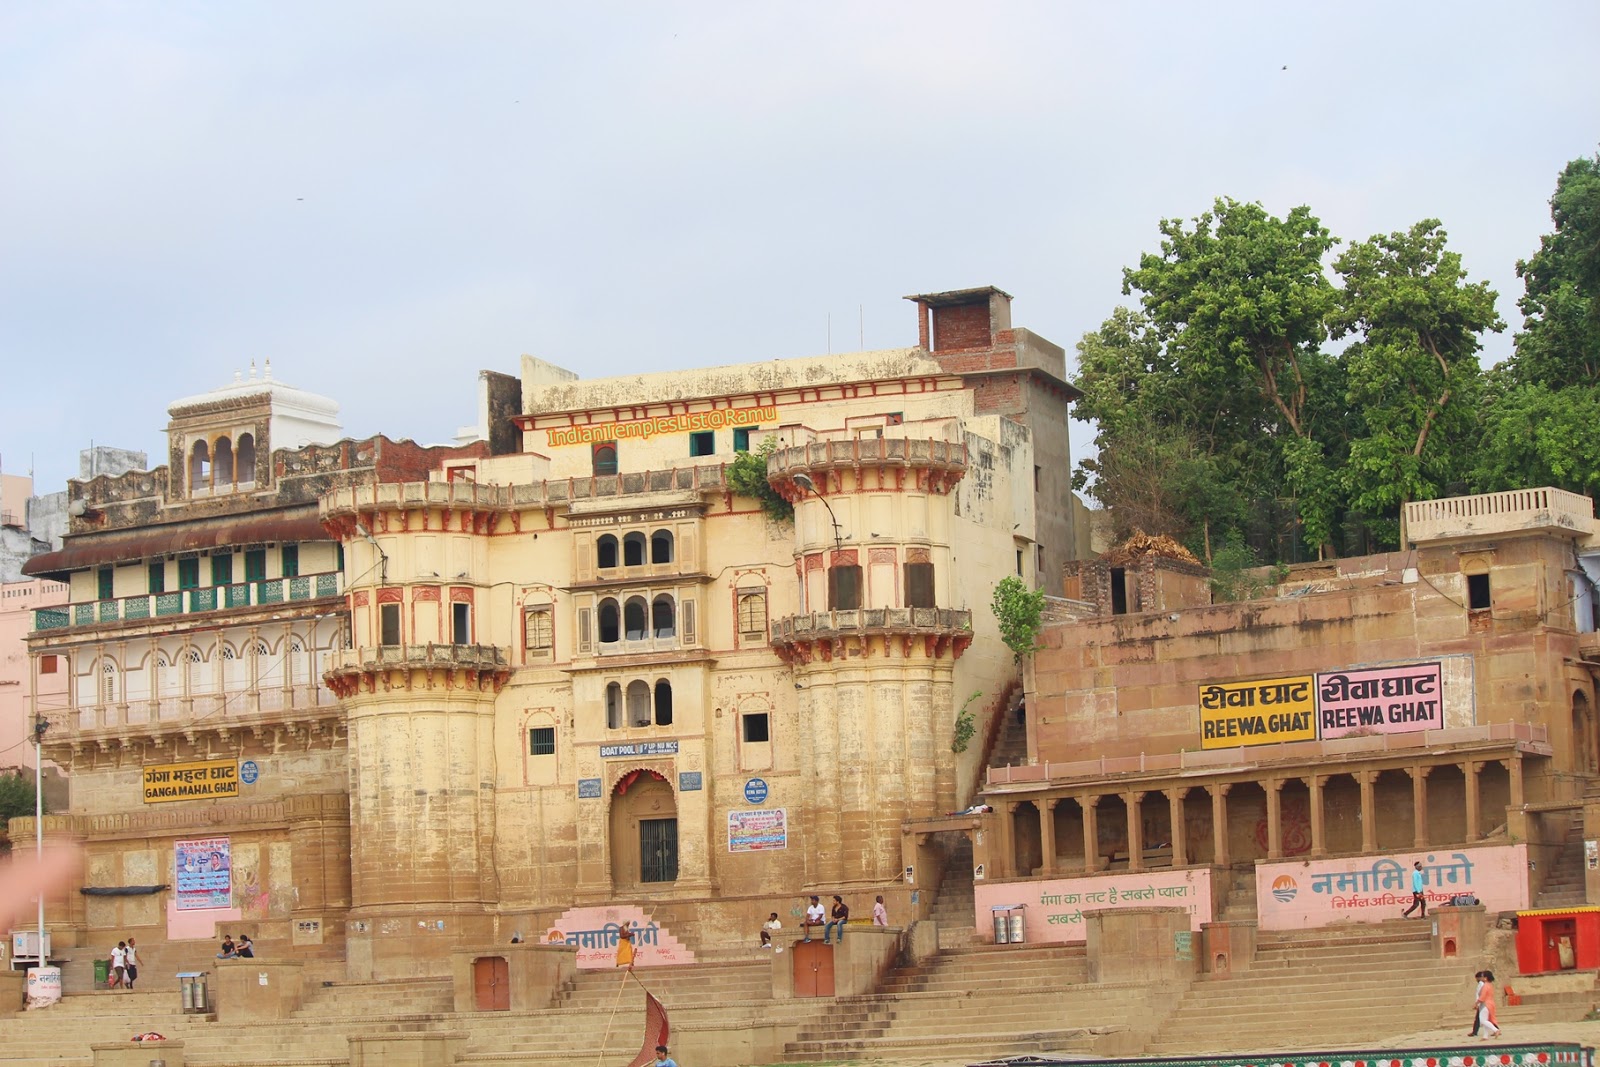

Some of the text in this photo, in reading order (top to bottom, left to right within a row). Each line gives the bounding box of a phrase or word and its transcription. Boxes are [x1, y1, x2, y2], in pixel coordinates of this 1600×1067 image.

[1202, 682, 1309, 710] रीवा घाट
[1321, 674, 1437, 703] रीवा घाट
[1204, 711, 1311, 739] REEWA GHAT
[1322, 700, 1438, 729] REEWA GHAT
[601, 746, 618, 756] BOAT
[145, 769, 171, 783] गंगा
[173, 768, 208, 783] महल
[210, 766, 236, 779] घाट
[145, 782, 237, 798] GANGA MAHAL GHAT
[1311, 853, 1475, 894] नमामि गंगे
[1040, 891, 1062, 906] गंगा
[1064, 893, 1082, 905] का
[1085, 891, 1107, 904] तट
[1109, 887, 1118, 905] है
[1120, 885, 1155, 901] सबसे
[1158, 885, 1189, 898] प्यारा
[1331, 894, 1369, 909] निर्मल
[1047, 909, 1082, 925] सबसे
